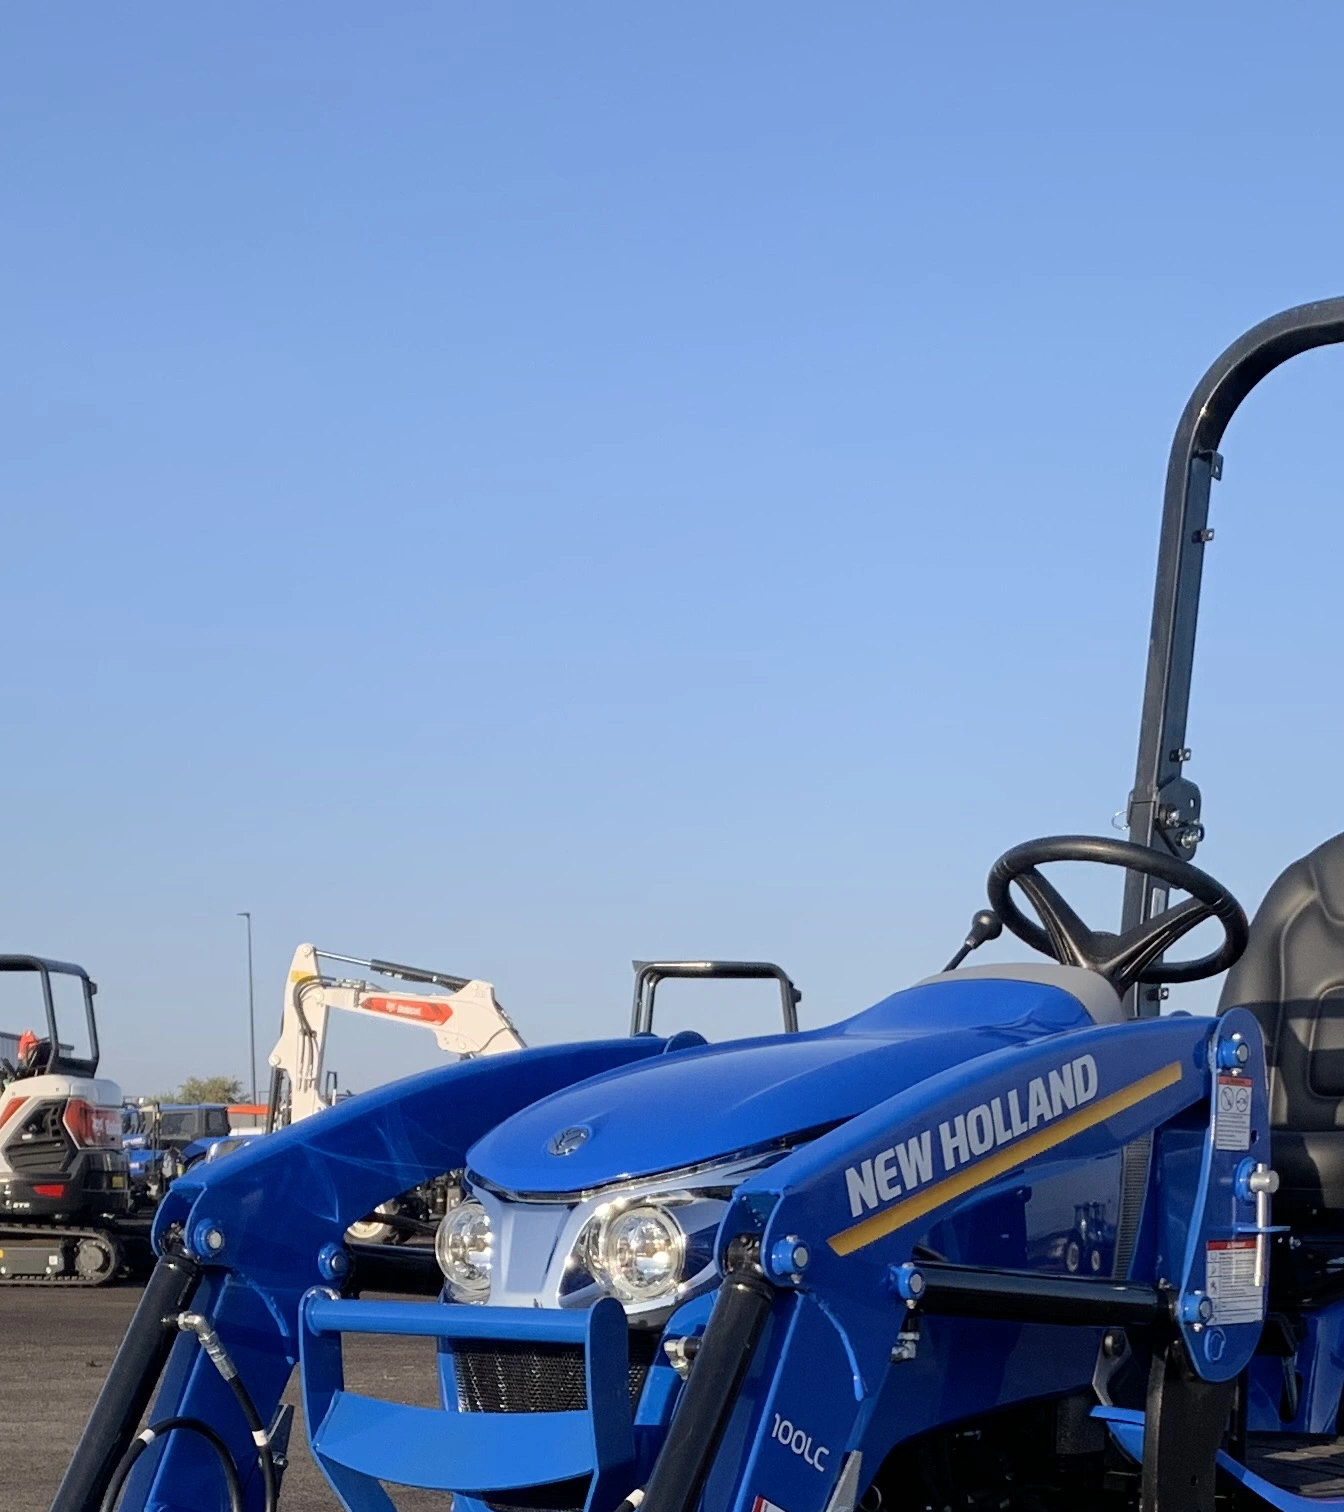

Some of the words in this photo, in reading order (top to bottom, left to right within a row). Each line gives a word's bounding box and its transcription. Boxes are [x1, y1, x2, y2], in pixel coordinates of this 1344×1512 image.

[845, 1130, 933, 1218] NEW
[938, 1054, 1098, 1171] HOLLAND
[771, 1412, 830, 1472] 100LC
